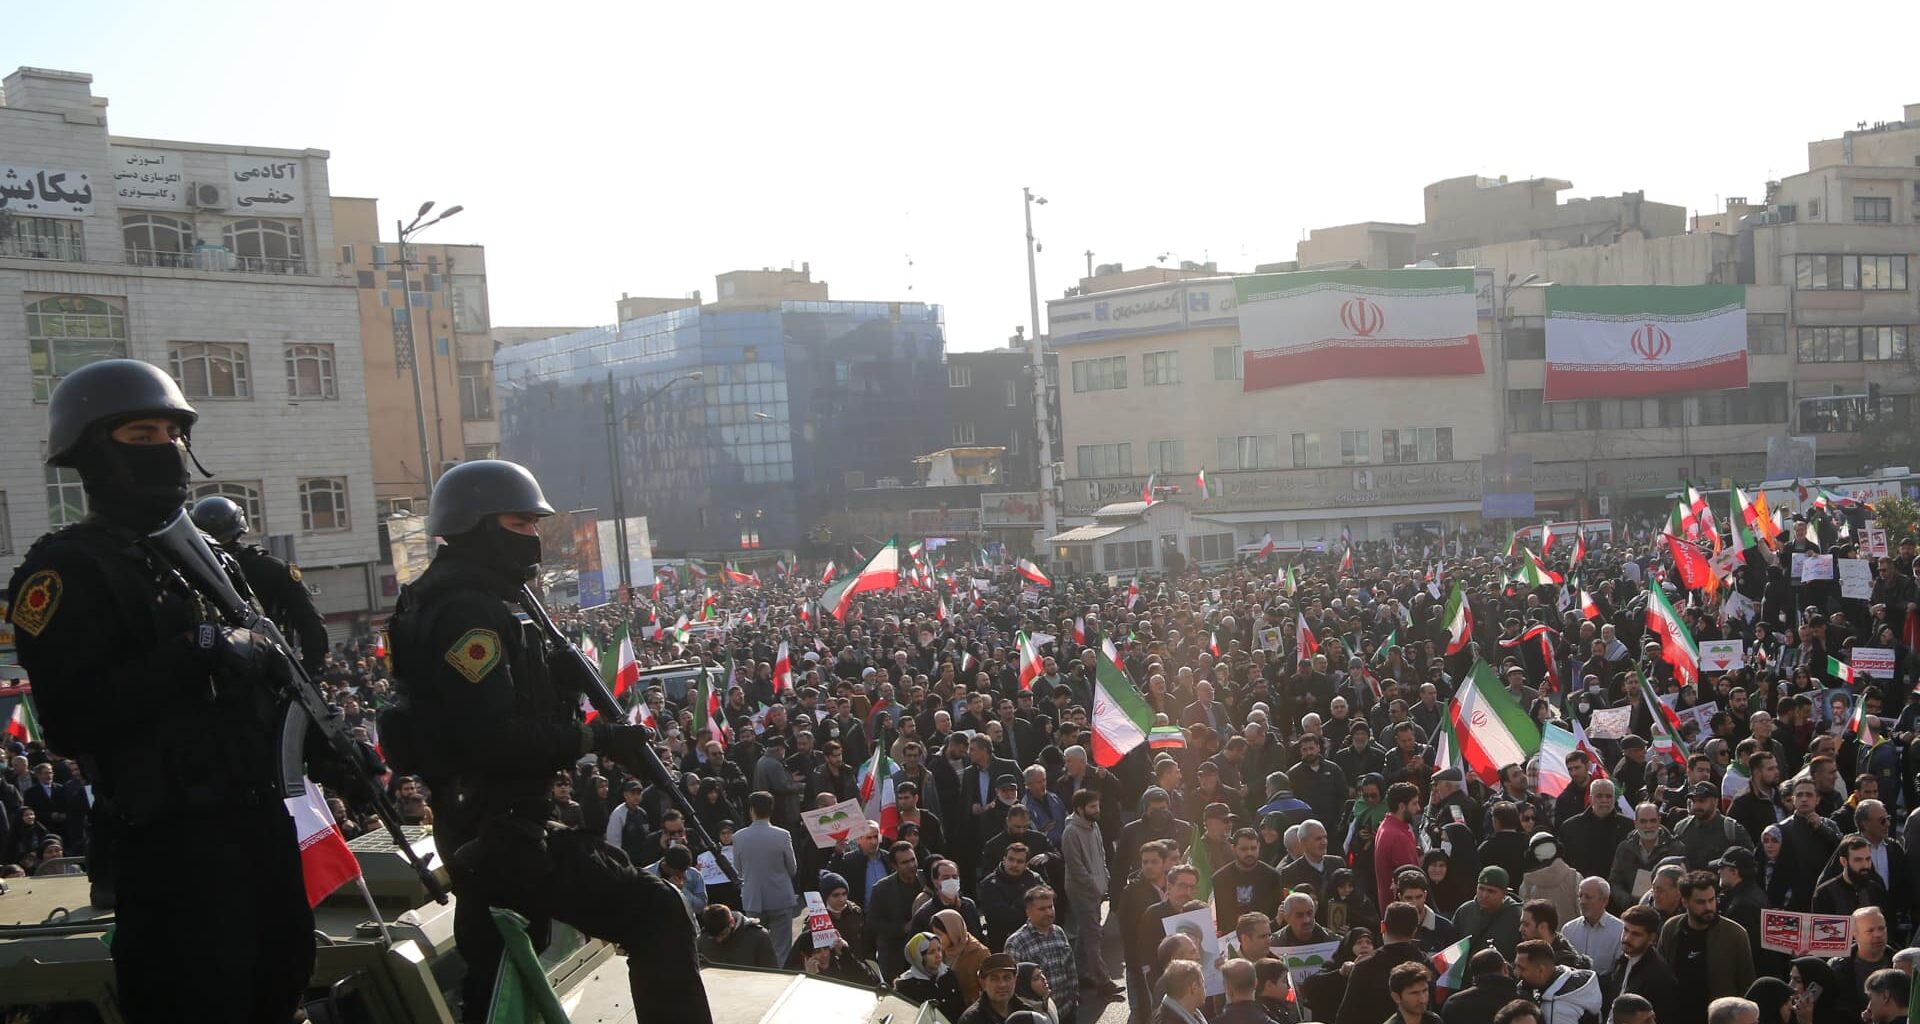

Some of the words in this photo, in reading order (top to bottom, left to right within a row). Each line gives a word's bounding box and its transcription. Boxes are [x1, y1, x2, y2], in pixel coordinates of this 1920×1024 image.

[127, 154, 165, 167] آموزش
[113, 170, 138, 180] دستی
[141, 172, 181, 184] الگوسازی
[234, 162, 297, 182] آکادمی
[119, 186, 169, 199] کامپیوتری
[170, 193, 177, 201] و
[237, 188, 295, 207] حنفی
